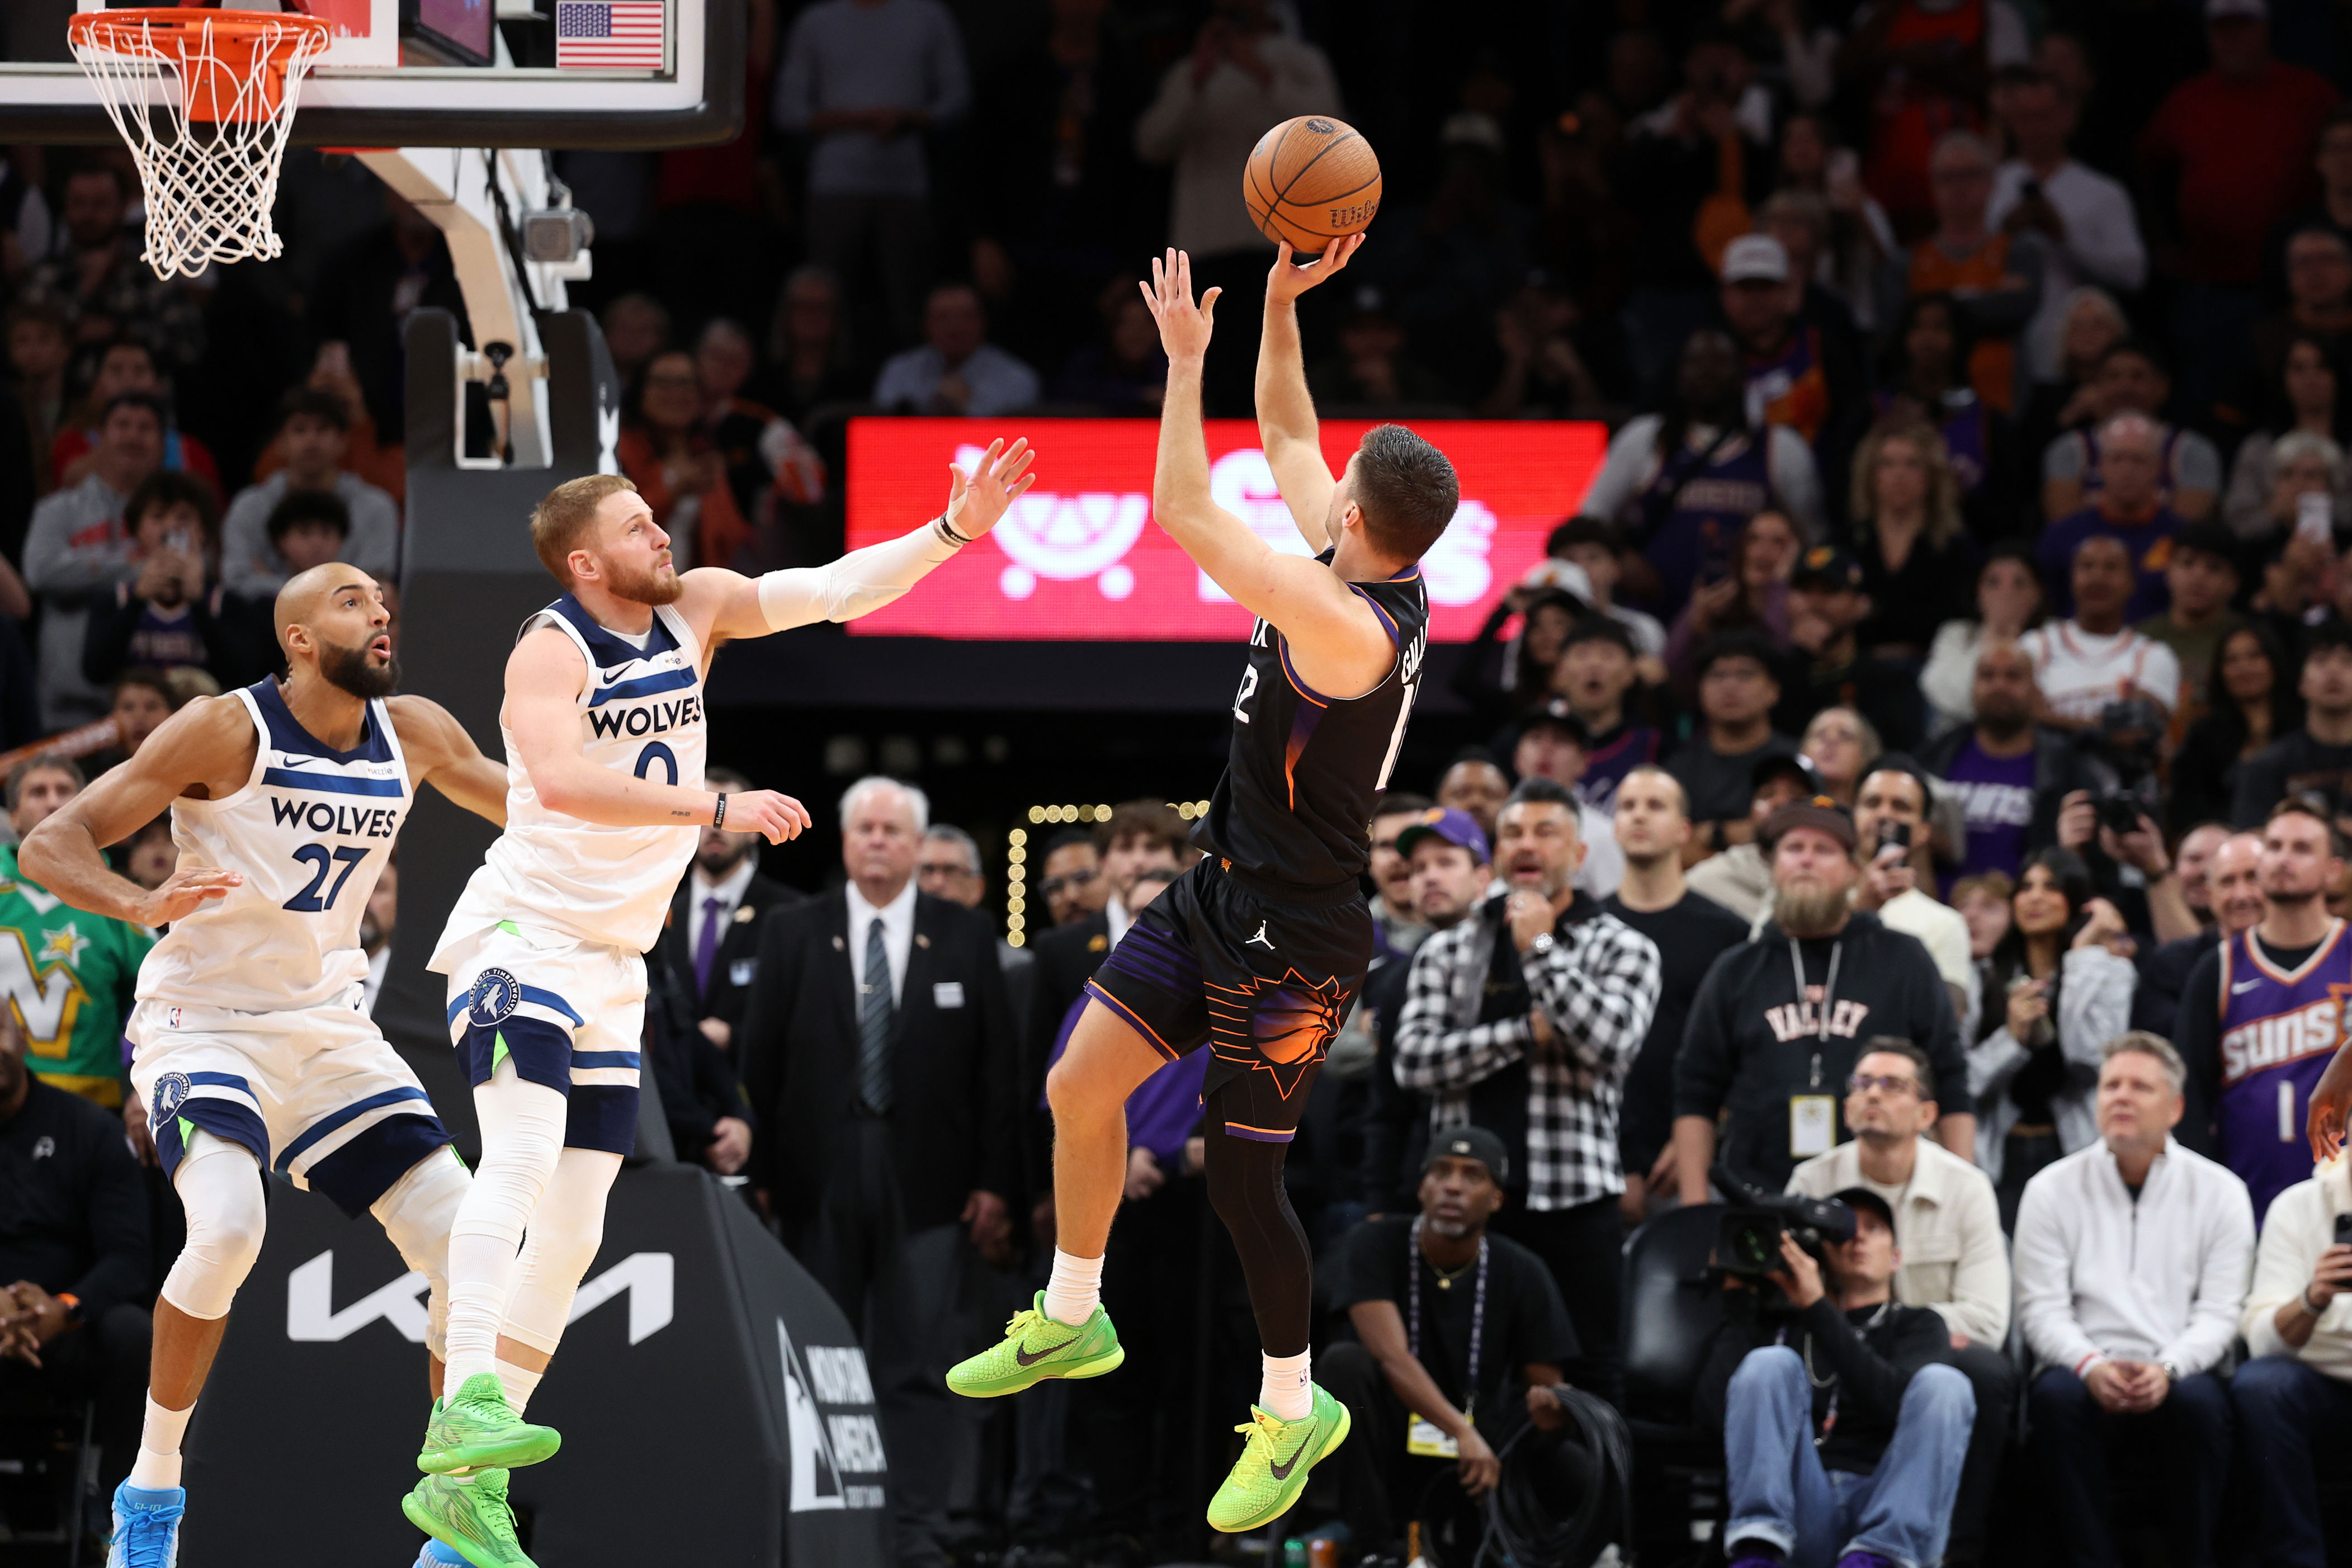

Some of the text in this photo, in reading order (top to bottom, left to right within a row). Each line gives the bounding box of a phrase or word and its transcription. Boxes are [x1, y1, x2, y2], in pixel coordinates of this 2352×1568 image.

[588, 695, 701, 739] WOLVES
[271, 796, 397, 838] WOLVES
[716, 800, 725, 824] Blessed
[282, 843, 371, 913] 27
[493, 969, 518, 1015] TIMBERWOLVES
[287, 1249, 674, 1346] KA
